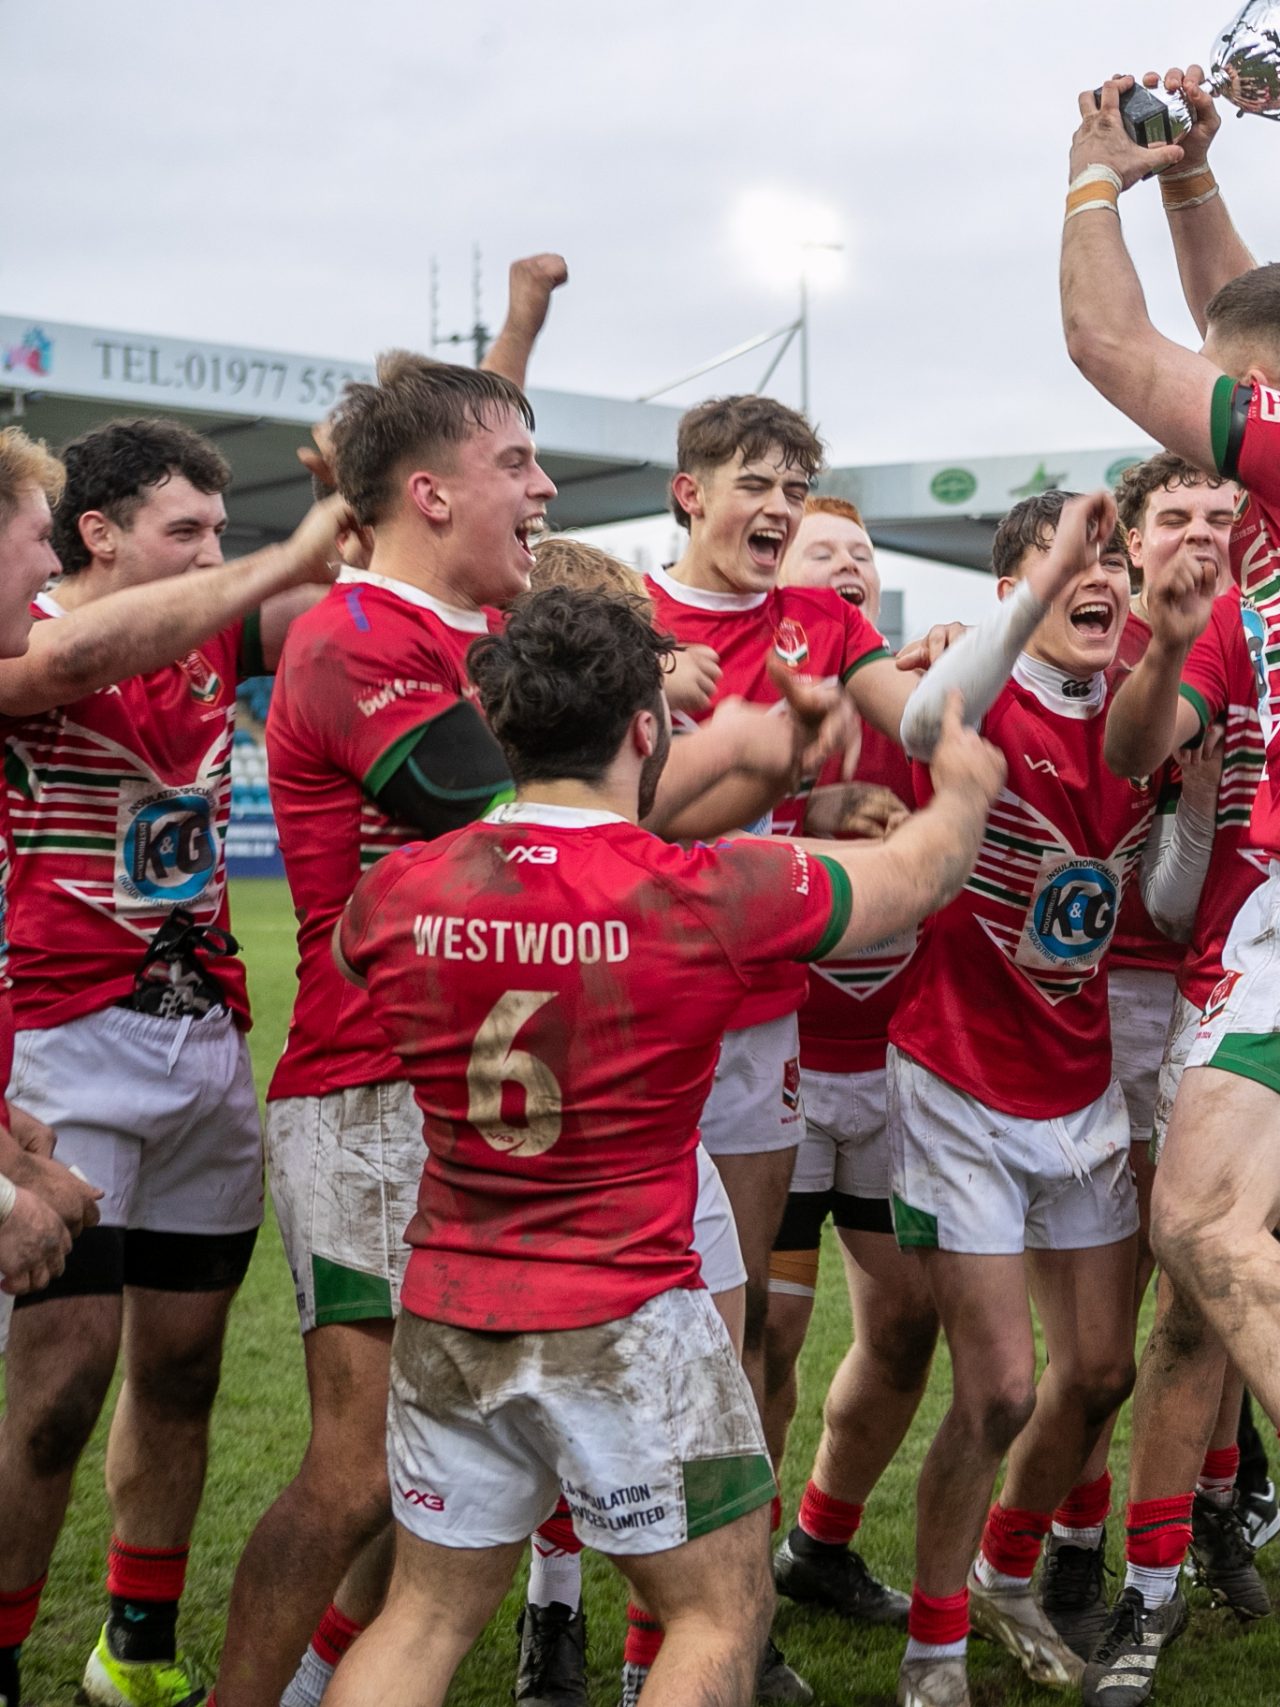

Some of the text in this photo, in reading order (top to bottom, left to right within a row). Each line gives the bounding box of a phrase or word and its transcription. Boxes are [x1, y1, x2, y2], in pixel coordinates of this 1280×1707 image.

[1024, 754, 1059, 777] VX
[494, 845, 558, 864] VX3
[1046, 859, 1089, 881] INSULATIO
[1040, 886, 1115, 938] K&G
[412, 914, 630, 966] WESTWOOD
[1027, 927, 1058, 964] INDUSTRIAL
[466, 989, 563, 1158] 6
[396, 1482, 445, 1512] VX3
[608, 1506, 665, 1532] LIMITED
